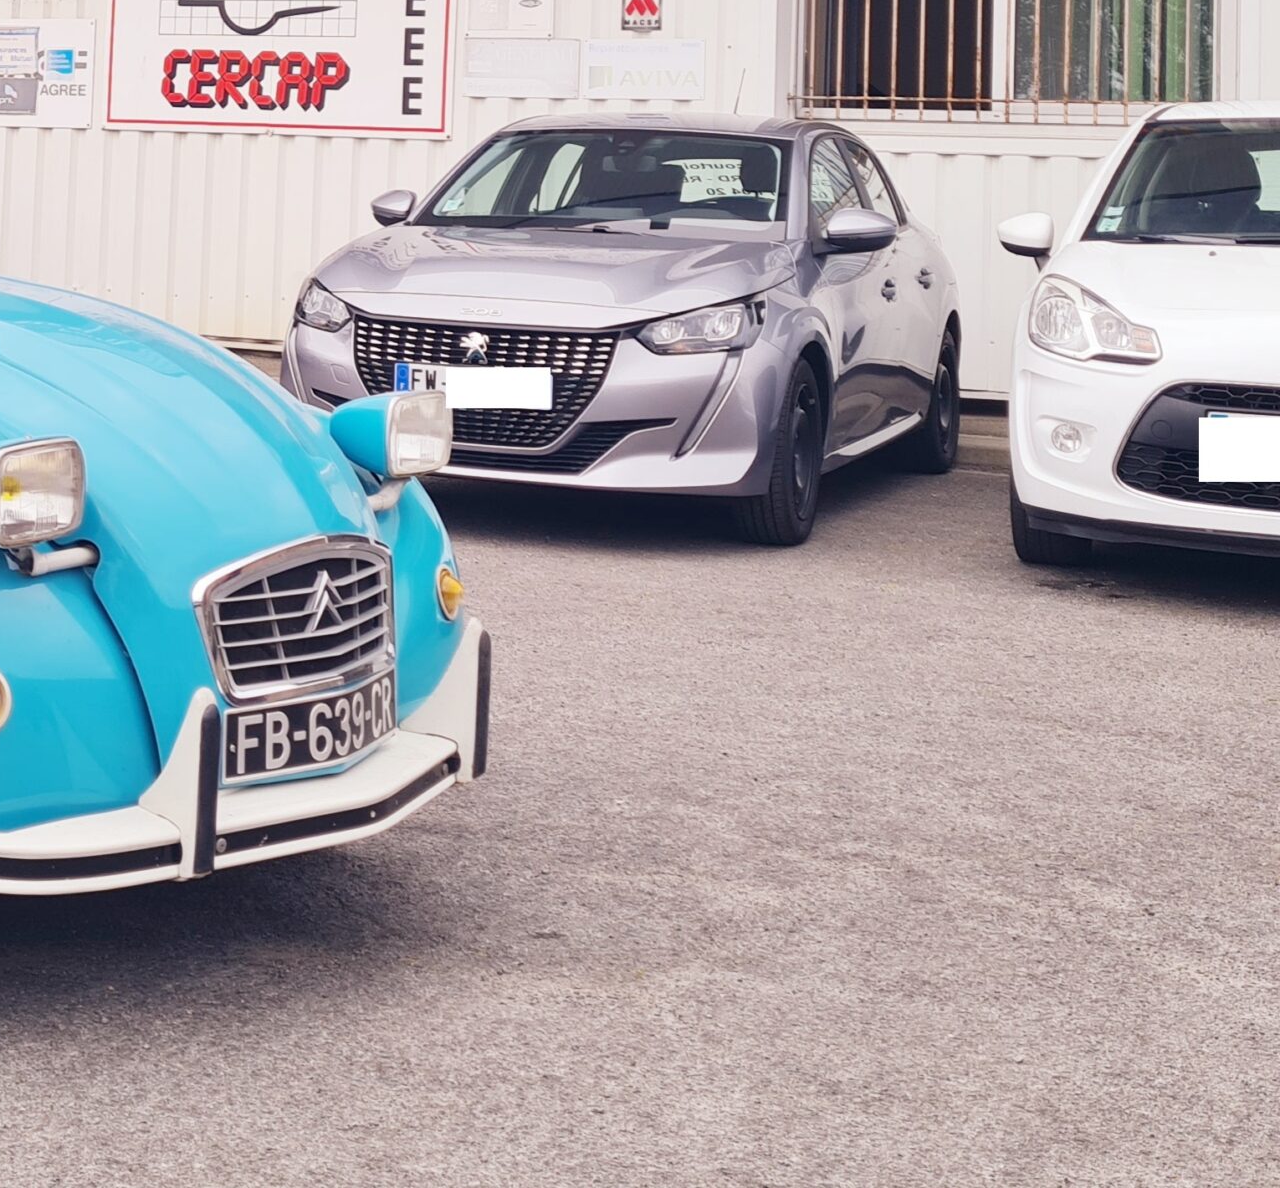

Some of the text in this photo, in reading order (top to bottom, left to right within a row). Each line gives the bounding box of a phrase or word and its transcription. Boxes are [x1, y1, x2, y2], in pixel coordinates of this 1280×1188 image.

[40, 84, 86, 96] AGREE
[161, 48, 351, 112] CERCAP
[619, 70, 700, 88] AVIVA
[236, 676, 394, 775] FB-639-CR
